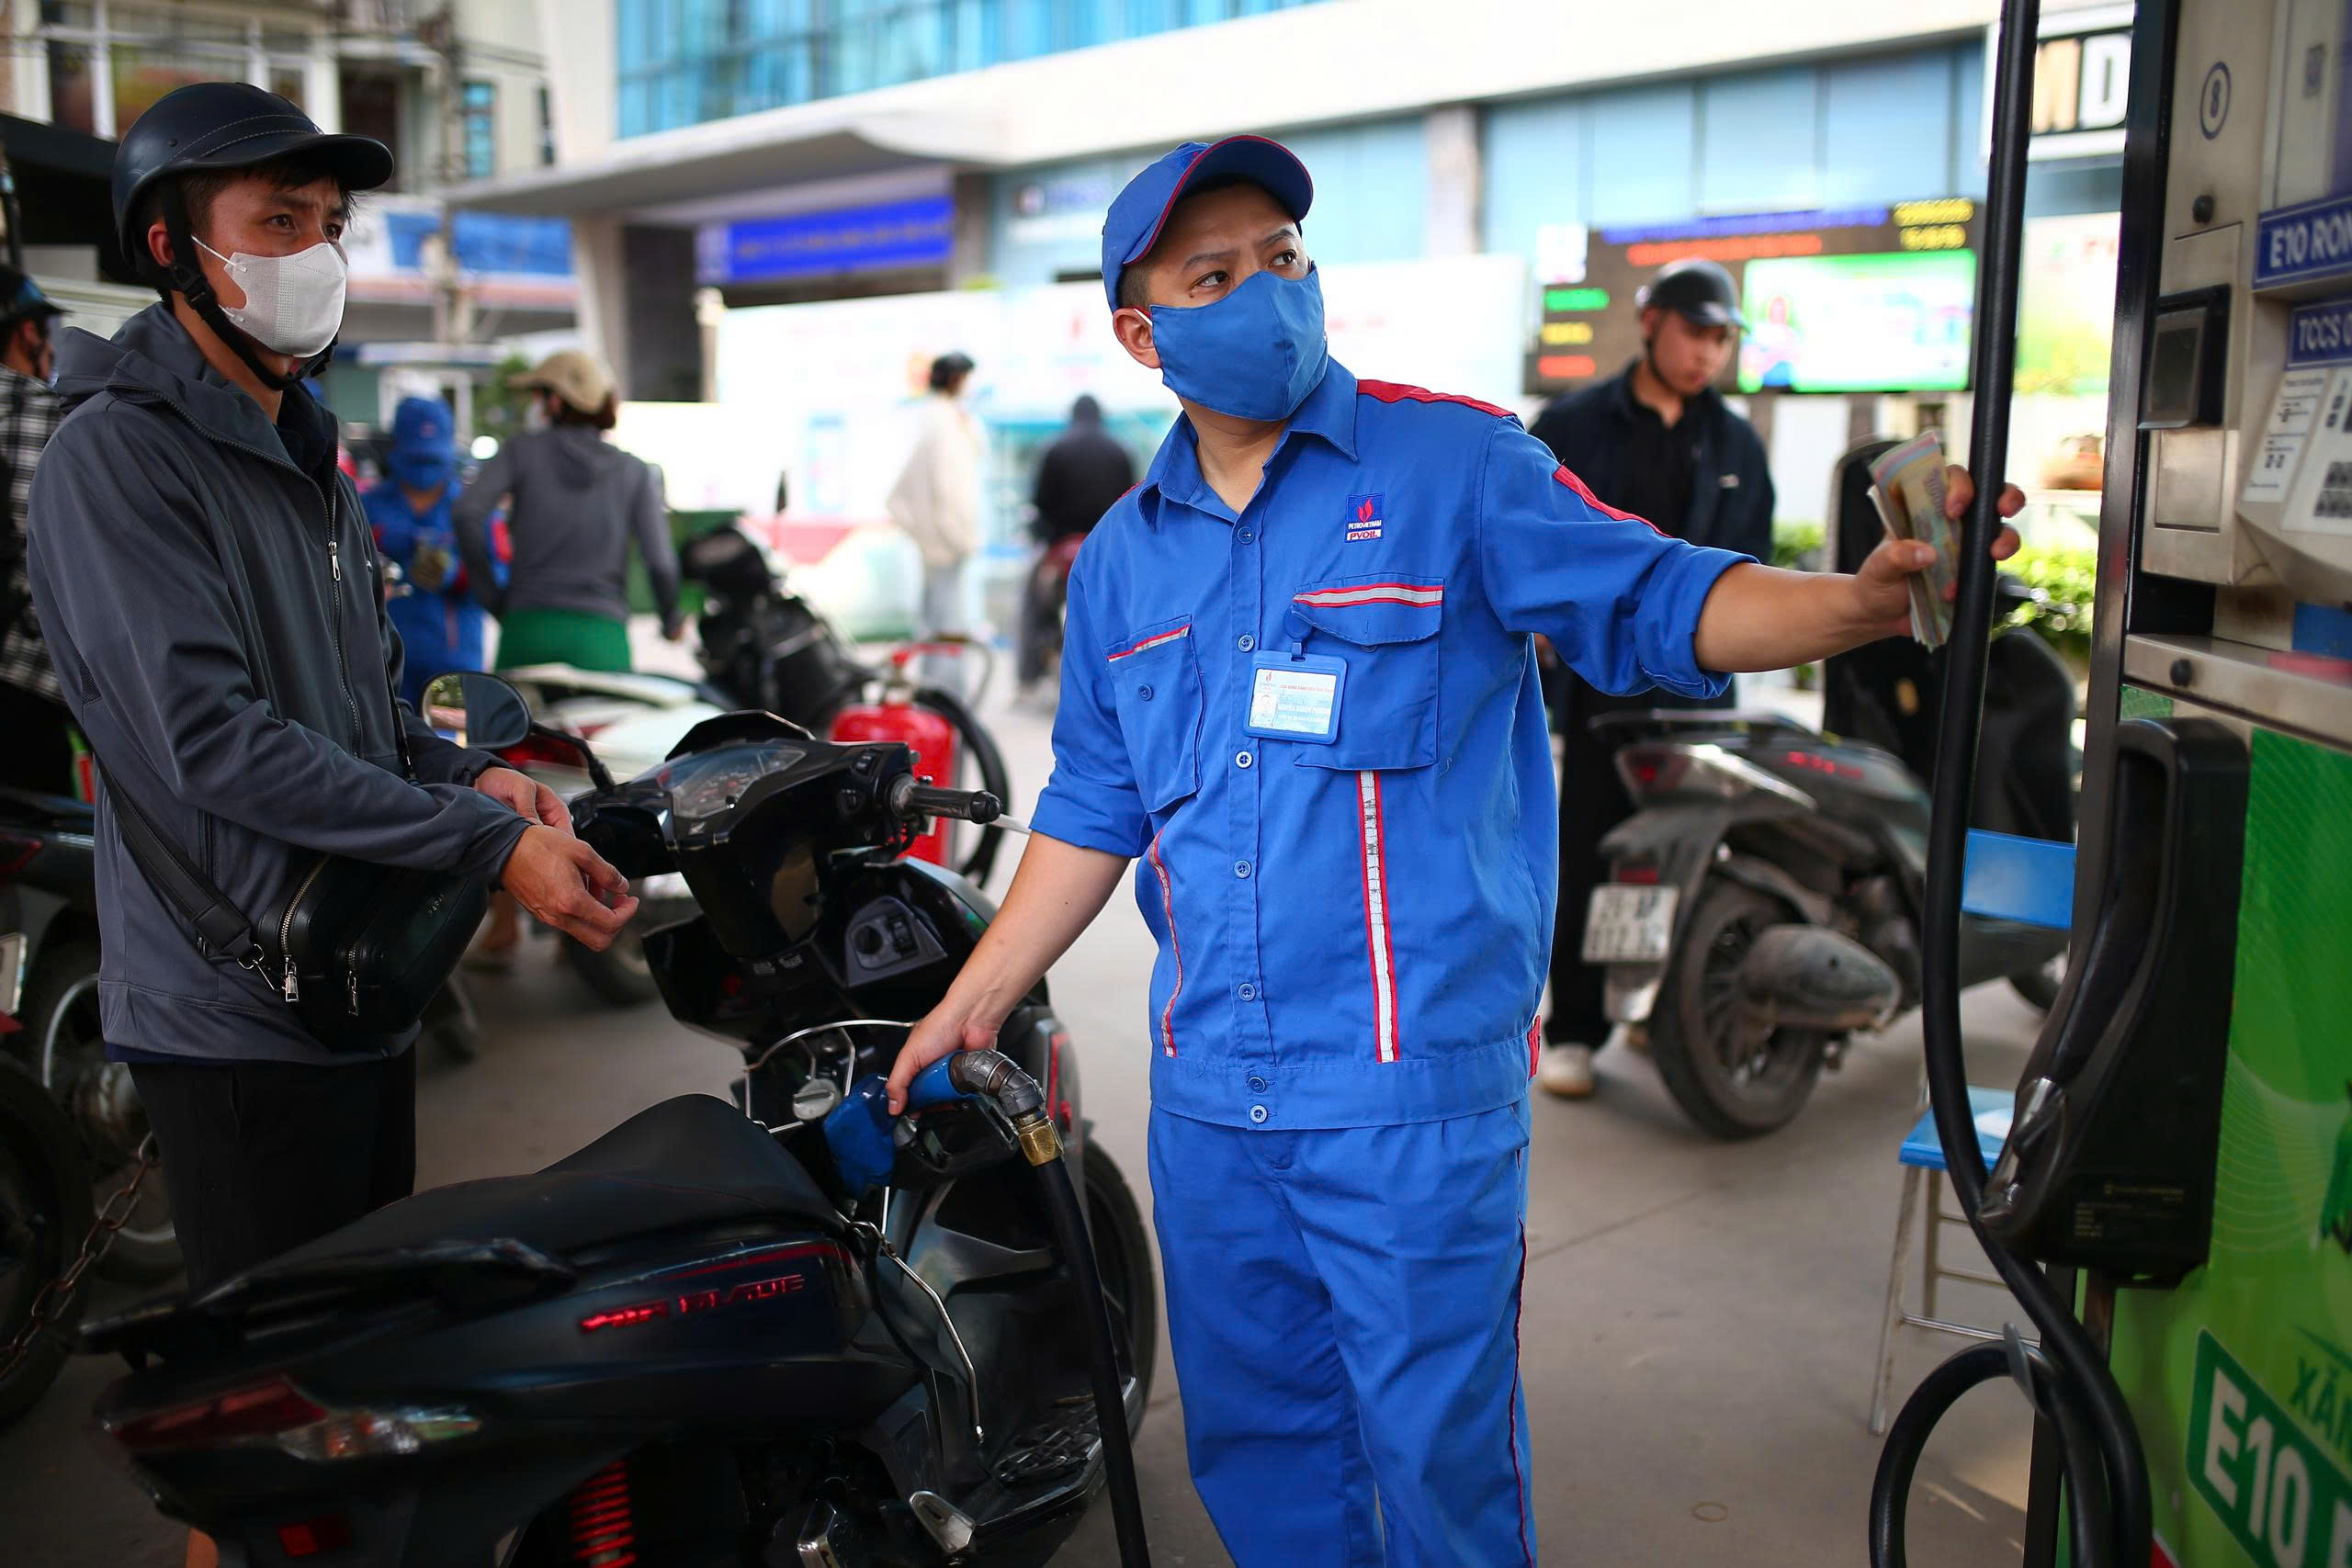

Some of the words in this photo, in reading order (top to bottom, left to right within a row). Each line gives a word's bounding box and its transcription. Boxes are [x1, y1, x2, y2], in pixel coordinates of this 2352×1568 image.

[2210, 79, 2222, 118] 8
[2270, 221, 2309, 267] E10
[2299, 314, 2340, 351] TCCS
[1348, 520, 1382, 529] PETROVIETNAM
[1350, 530, 1378, 540] PVOIL
[2204, 1366, 2311, 1568] E10
